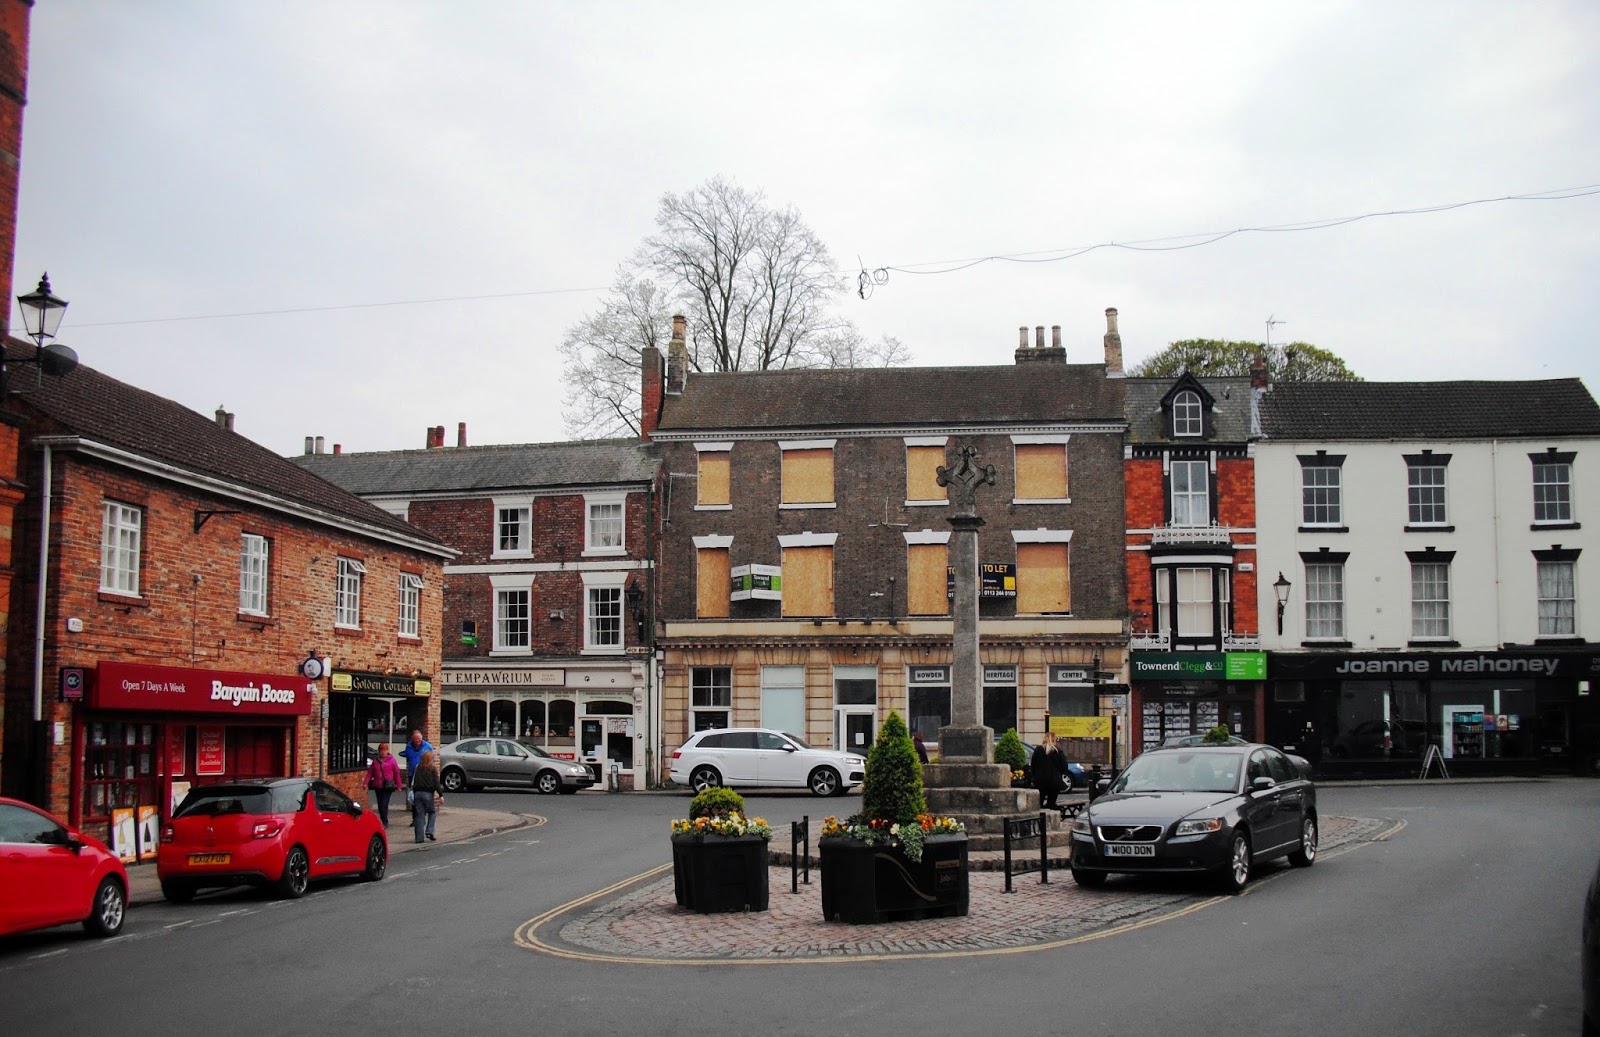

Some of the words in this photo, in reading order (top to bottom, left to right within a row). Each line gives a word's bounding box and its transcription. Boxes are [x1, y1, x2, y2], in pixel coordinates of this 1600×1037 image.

[1336, 659, 1429, 674] Joanne
[1442, 656, 1559, 676] Mahoney
[122, 680, 140, 692] Open
[141, 681, 146, 690] 7
[147, 681, 162, 693] Days
[163, 683, 169, 692] A
[170, 683, 186, 693] Week
[211, 680, 260, 706] Bargain
[261, 684, 295, 704] Booze
[1134, 846, 1152, 854] DON
